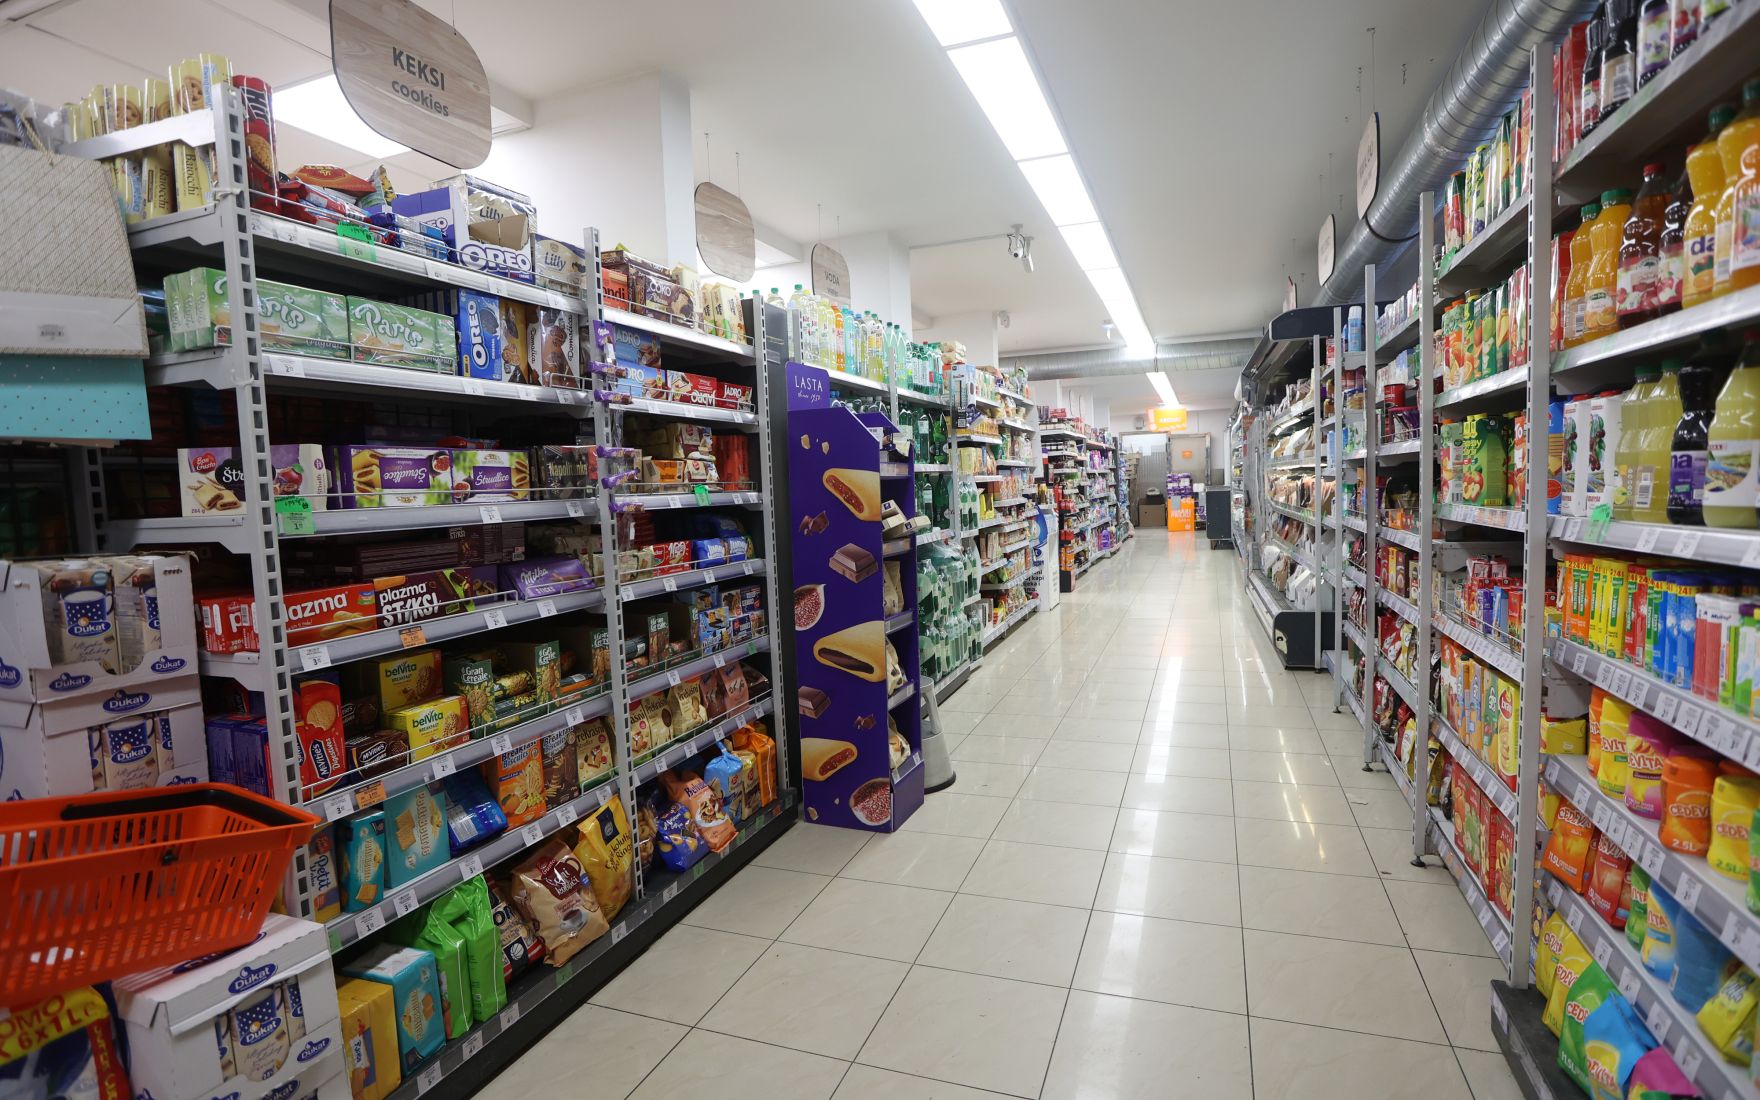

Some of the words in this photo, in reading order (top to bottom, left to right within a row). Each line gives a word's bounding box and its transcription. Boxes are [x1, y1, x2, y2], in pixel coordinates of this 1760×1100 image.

[392, 47, 445, 91] KEKSI
[392, 80, 449, 117] cookies
[480, 206, 503, 224] Lilly
[1690, 235, 1715, 256] da
[460, 244, 531, 272] OREO
[544, 252, 566, 272] Lilly
[353, 303, 424, 347] Paris
[467, 301, 488, 368] OREO
[615, 332, 641, 347] ADRO
[794, 375, 823, 393] LASTA
[519, 567, 549, 585] Milka
[379, 584, 427, 606] plazma
[74, 622, 106, 634] Dukat
[155, 658, 182, 671] Dukat
[384, 661, 417, 678] belVita
[465, 666, 484, 677] Gran
[0, 669, 17, 681] ukat
[55, 677, 87, 689] Dukat
[462, 672, 489, 683] Cereale
[109, 694, 145, 708] Dukat
[412, 711, 444, 728] belVita
[117, 746, 148, 761] Dukat
[503, 751, 530, 769] Biscuits
[1628, 752, 1664, 770] EVITA
[235, 967, 270, 991] Dukat
[246, 1020, 278, 1044] Dukat
[299, 1040, 327, 1059] Dukat
